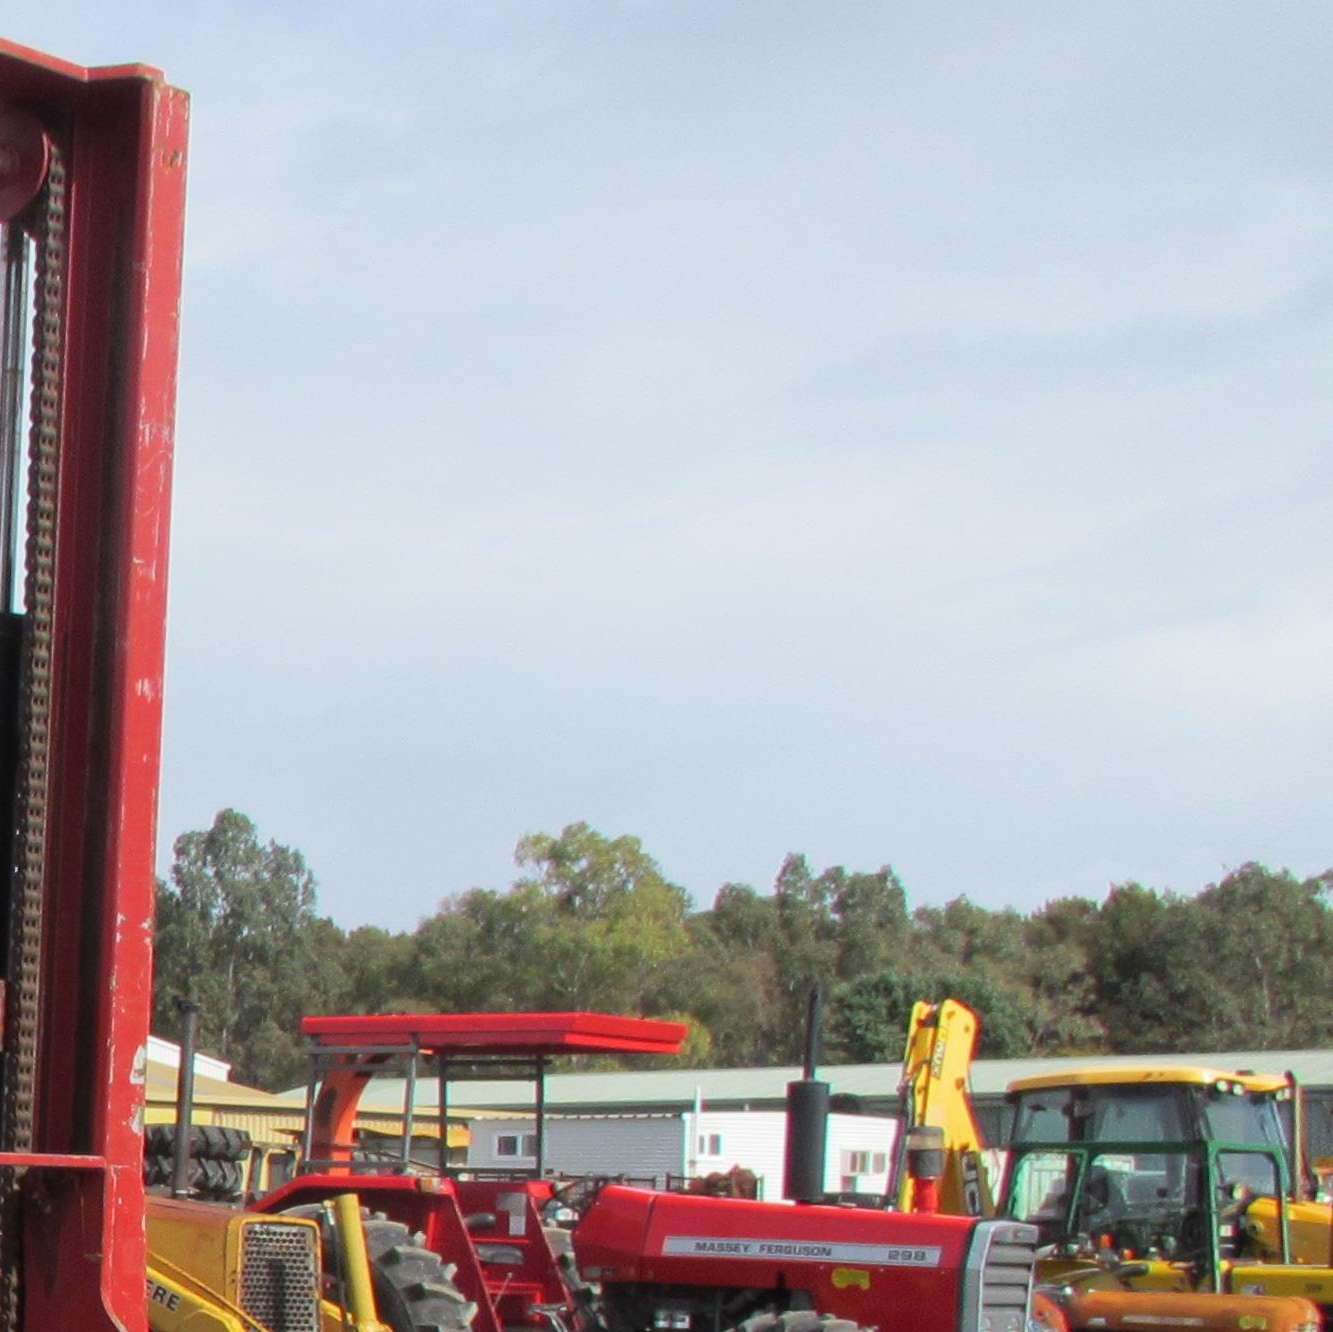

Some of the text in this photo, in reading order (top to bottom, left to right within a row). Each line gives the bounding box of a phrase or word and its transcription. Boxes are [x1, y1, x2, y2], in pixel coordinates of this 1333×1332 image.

[694, 1241, 926, 1262] MASSEY FERGUSON 298
